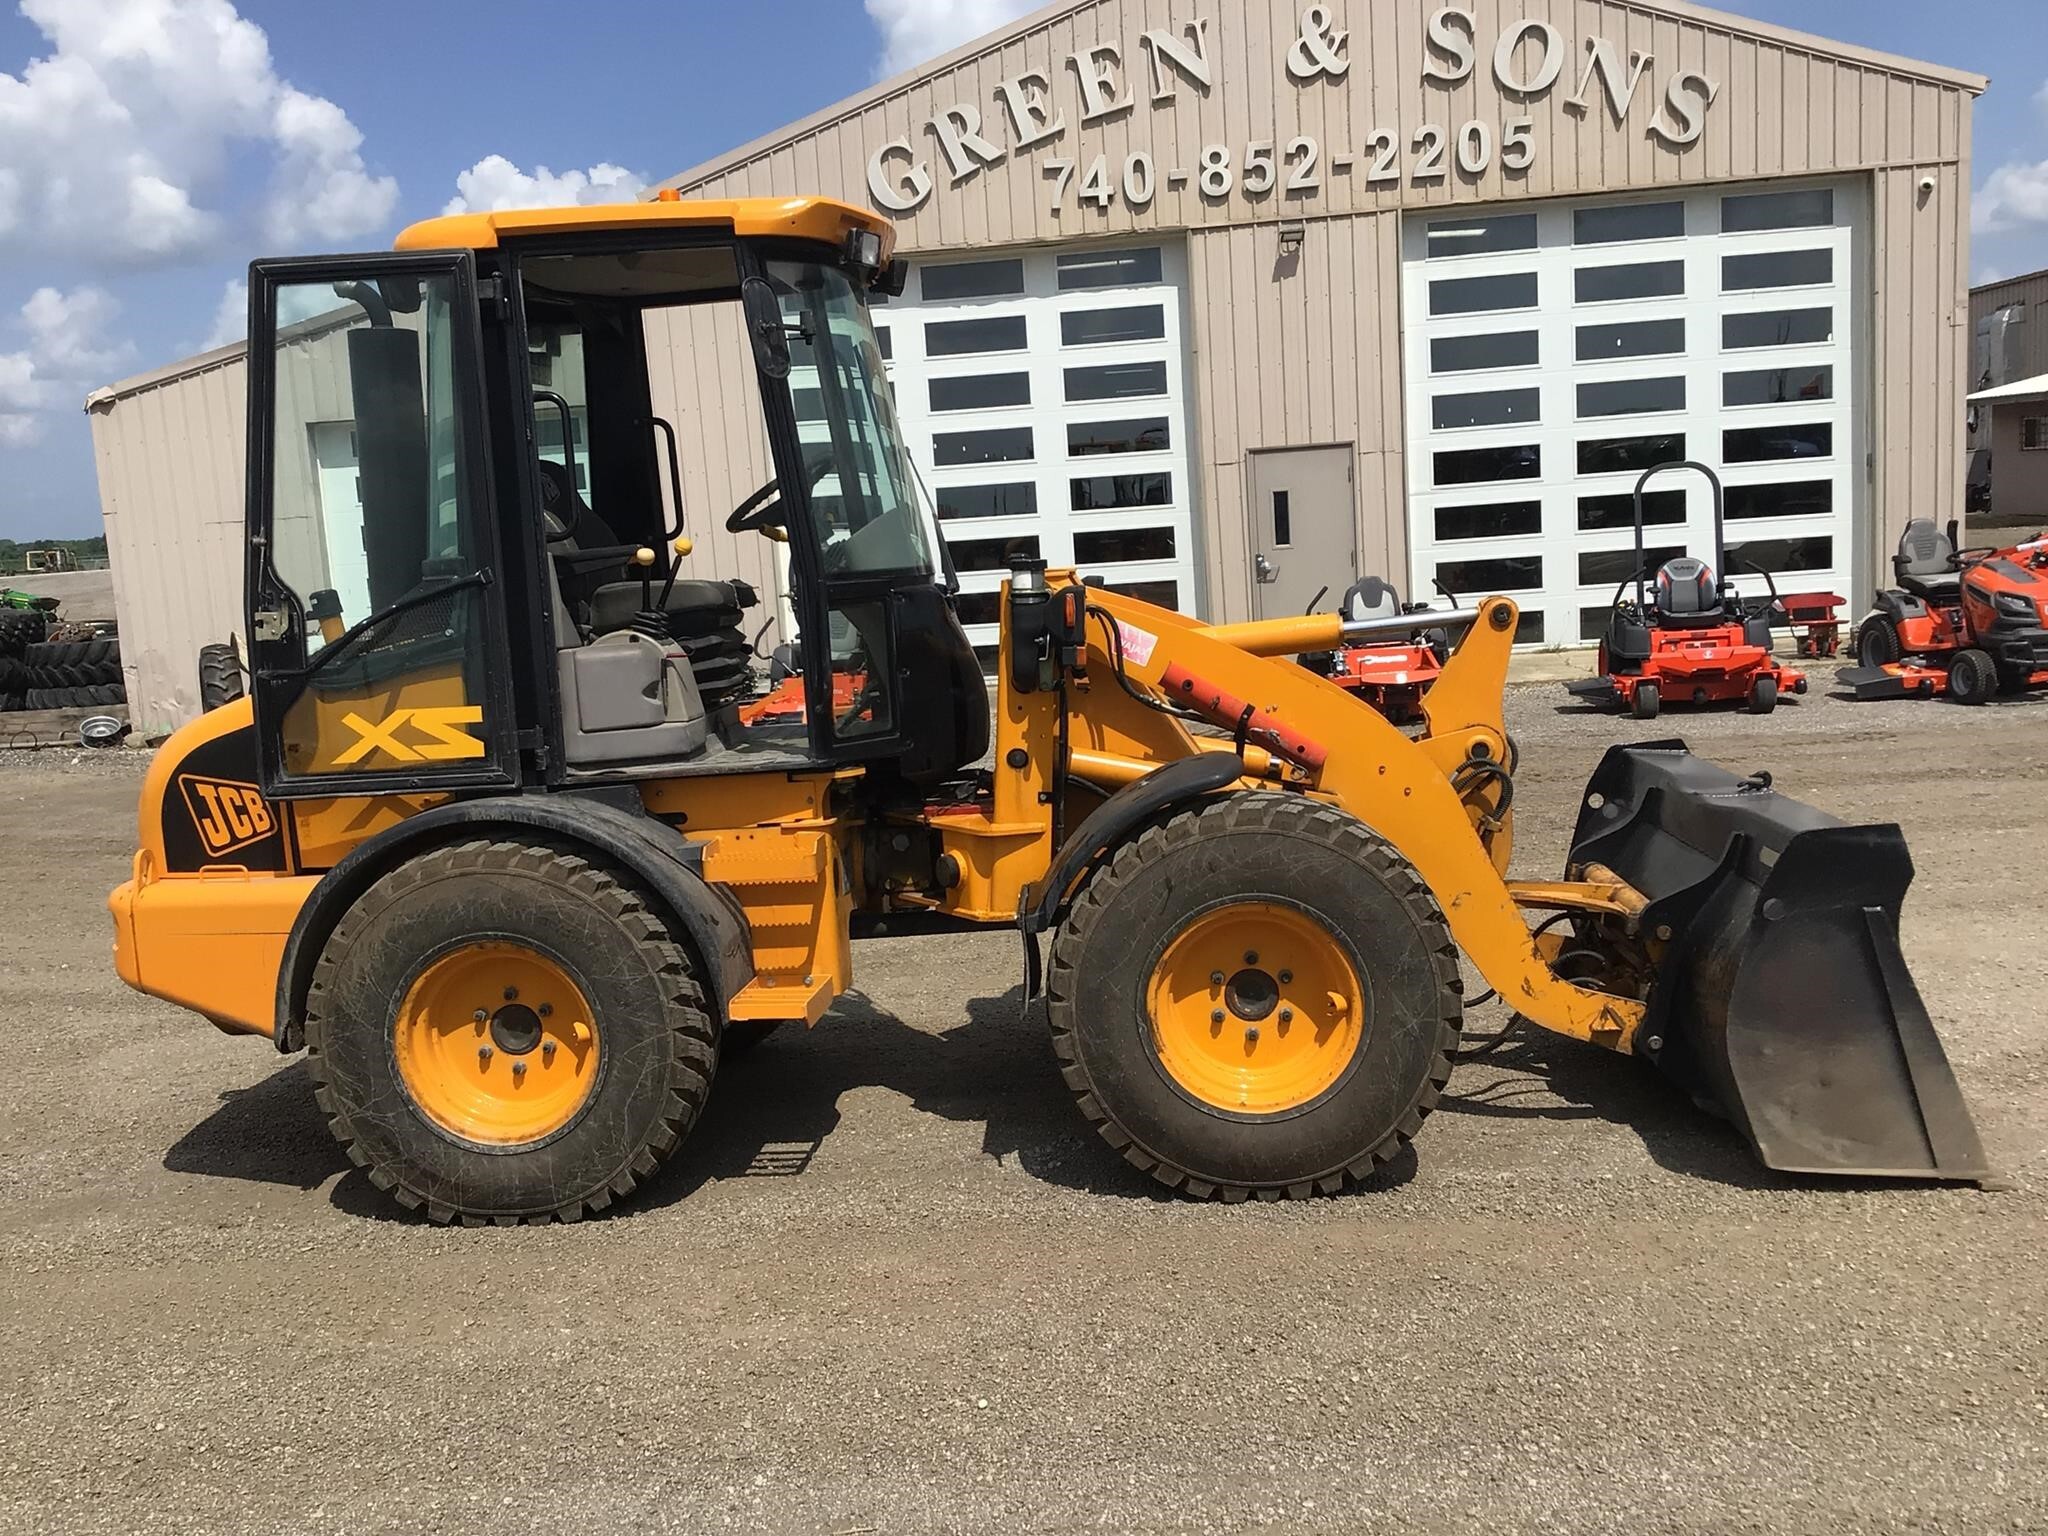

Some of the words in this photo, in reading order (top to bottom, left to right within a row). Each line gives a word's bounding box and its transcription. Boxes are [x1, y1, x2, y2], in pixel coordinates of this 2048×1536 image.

[867, 17, 1211, 210] GREEN
[1287, 5, 1351, 77] &
[1422, 6, 1720, 144] SONS
[1043, 115, 1536, 209] 740-852-2205
[194, 783, 271, 847] JCB
